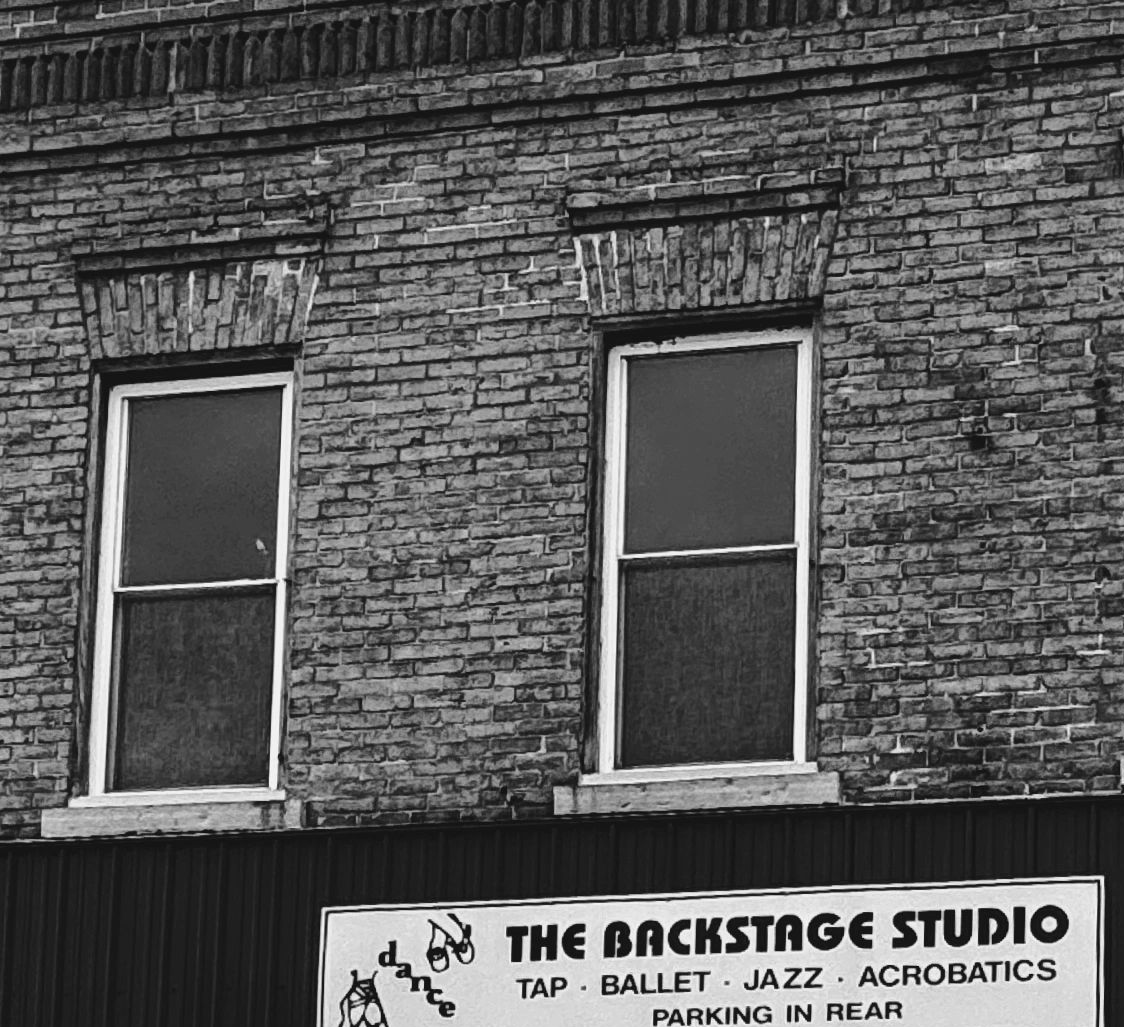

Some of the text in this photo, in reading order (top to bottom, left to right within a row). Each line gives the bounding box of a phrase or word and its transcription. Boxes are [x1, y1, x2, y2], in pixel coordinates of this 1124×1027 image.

[505, 904, 1070, 963] THE BACKSTAGE STUDIO
[378, 940, 456, 1018] dance
[515, 958, 1057, 1000] TAP BALLET JAZZ ACROBATICS
[652, 1001, 904, 1027] PARKING IN REAR
